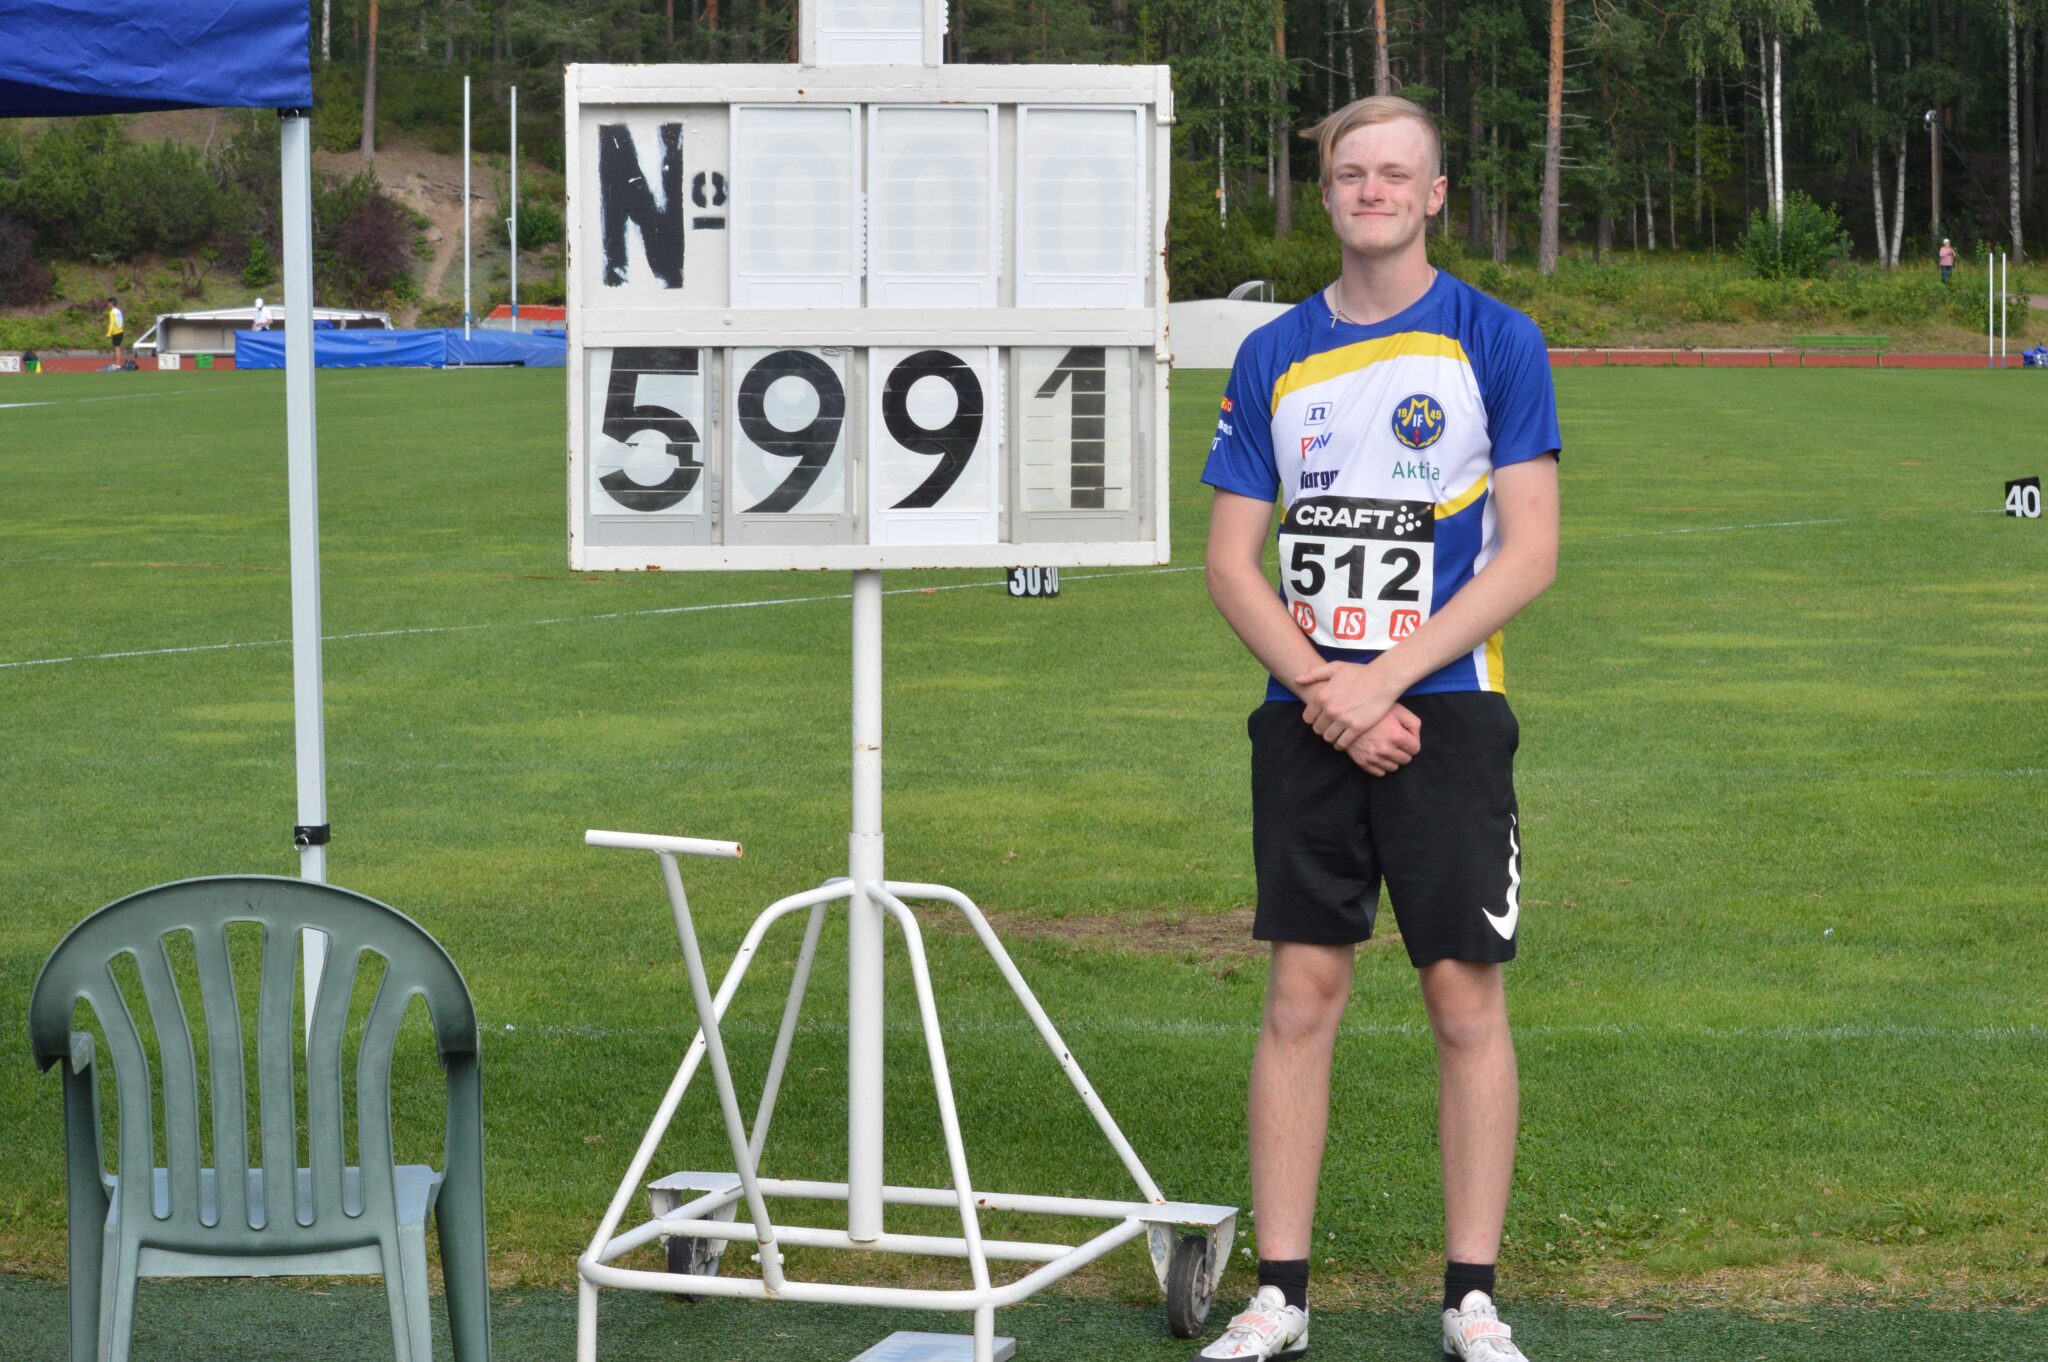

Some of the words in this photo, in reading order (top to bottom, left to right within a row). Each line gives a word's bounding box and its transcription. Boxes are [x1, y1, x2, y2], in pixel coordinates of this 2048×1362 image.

[1412, 414, 1424, 427] IF
[1391, 461, 1440, 480] Aktia
[2005, 485, 2041, 518] 40
[1295, 504, 1394, 530] CRAFT
[1009, 567, 1041, 596] 30
[1290, 541, 1421, 602] 512
[1336, 611, 1362, 635] IS
[1392, 614, 1417, 637] IS
